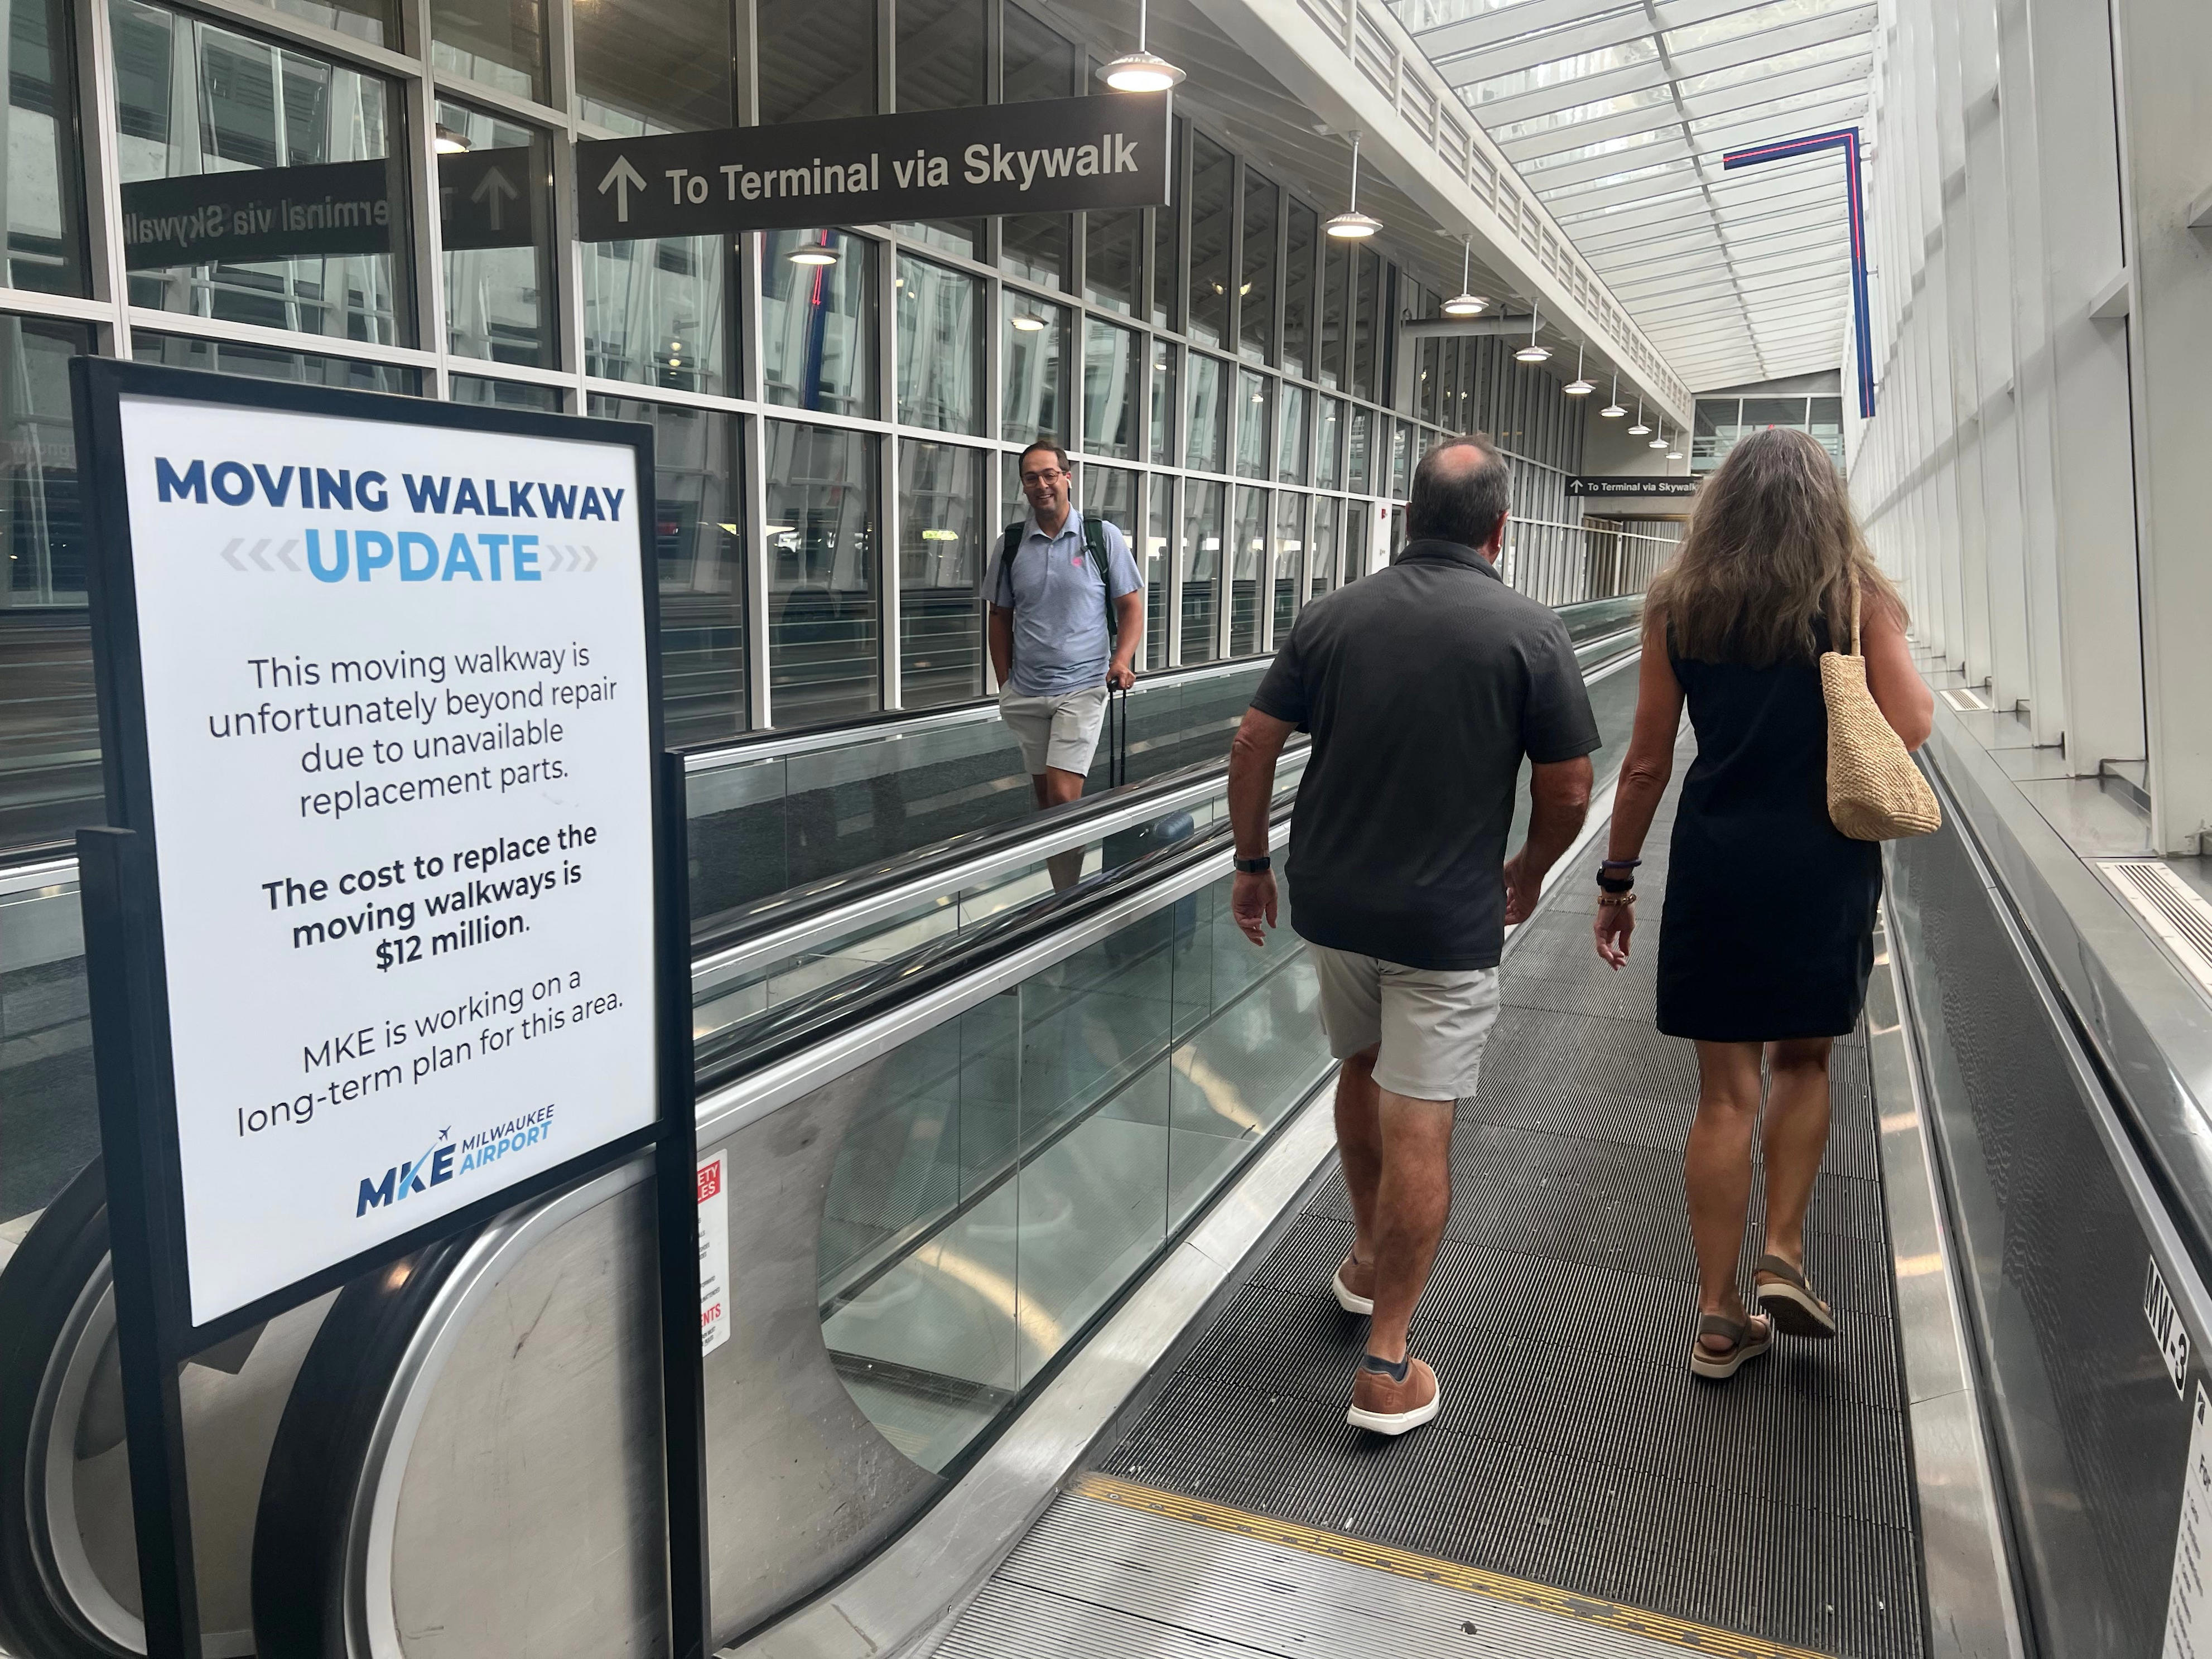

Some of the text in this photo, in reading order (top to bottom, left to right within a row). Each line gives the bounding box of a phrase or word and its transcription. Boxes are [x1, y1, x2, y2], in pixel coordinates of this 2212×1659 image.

[666, 133, 1138, 204] To Terminal via Skywalk
[155, 457, 624, 521] MOVING WALKWAY
[1601, 482, 1640, 491] Terminal
[1642, 483, 1656, 491] via
[1658, 482, 1698, 493] Skywalk
[306, 529, 541, 582] UPDATE
[248, 643, 589, 688] This moving walkway is
[210, 677, 616, 737] unfortunately beyond repair
[302, 718, 562, 773] due to unavailable
[301, 759, 567, 819] replacement parts.
[262, 824, 596, 910] The cost to replace the
[293, 860, 581, 948] moving walkways is
[377, 915, 529, 972] $12 million.
[305, 972, 580, 1073] MKE is working on a
[239, 992, 623, 1136] long-term plan for this area.
[459, 1120, 552, 1175] AIRPORT
[462, 1103, 555, 1154] MILWAUKEE
[356, 1144, 456, 1218] MKE
[2145, 1259, 2187, 1390] MW-3
